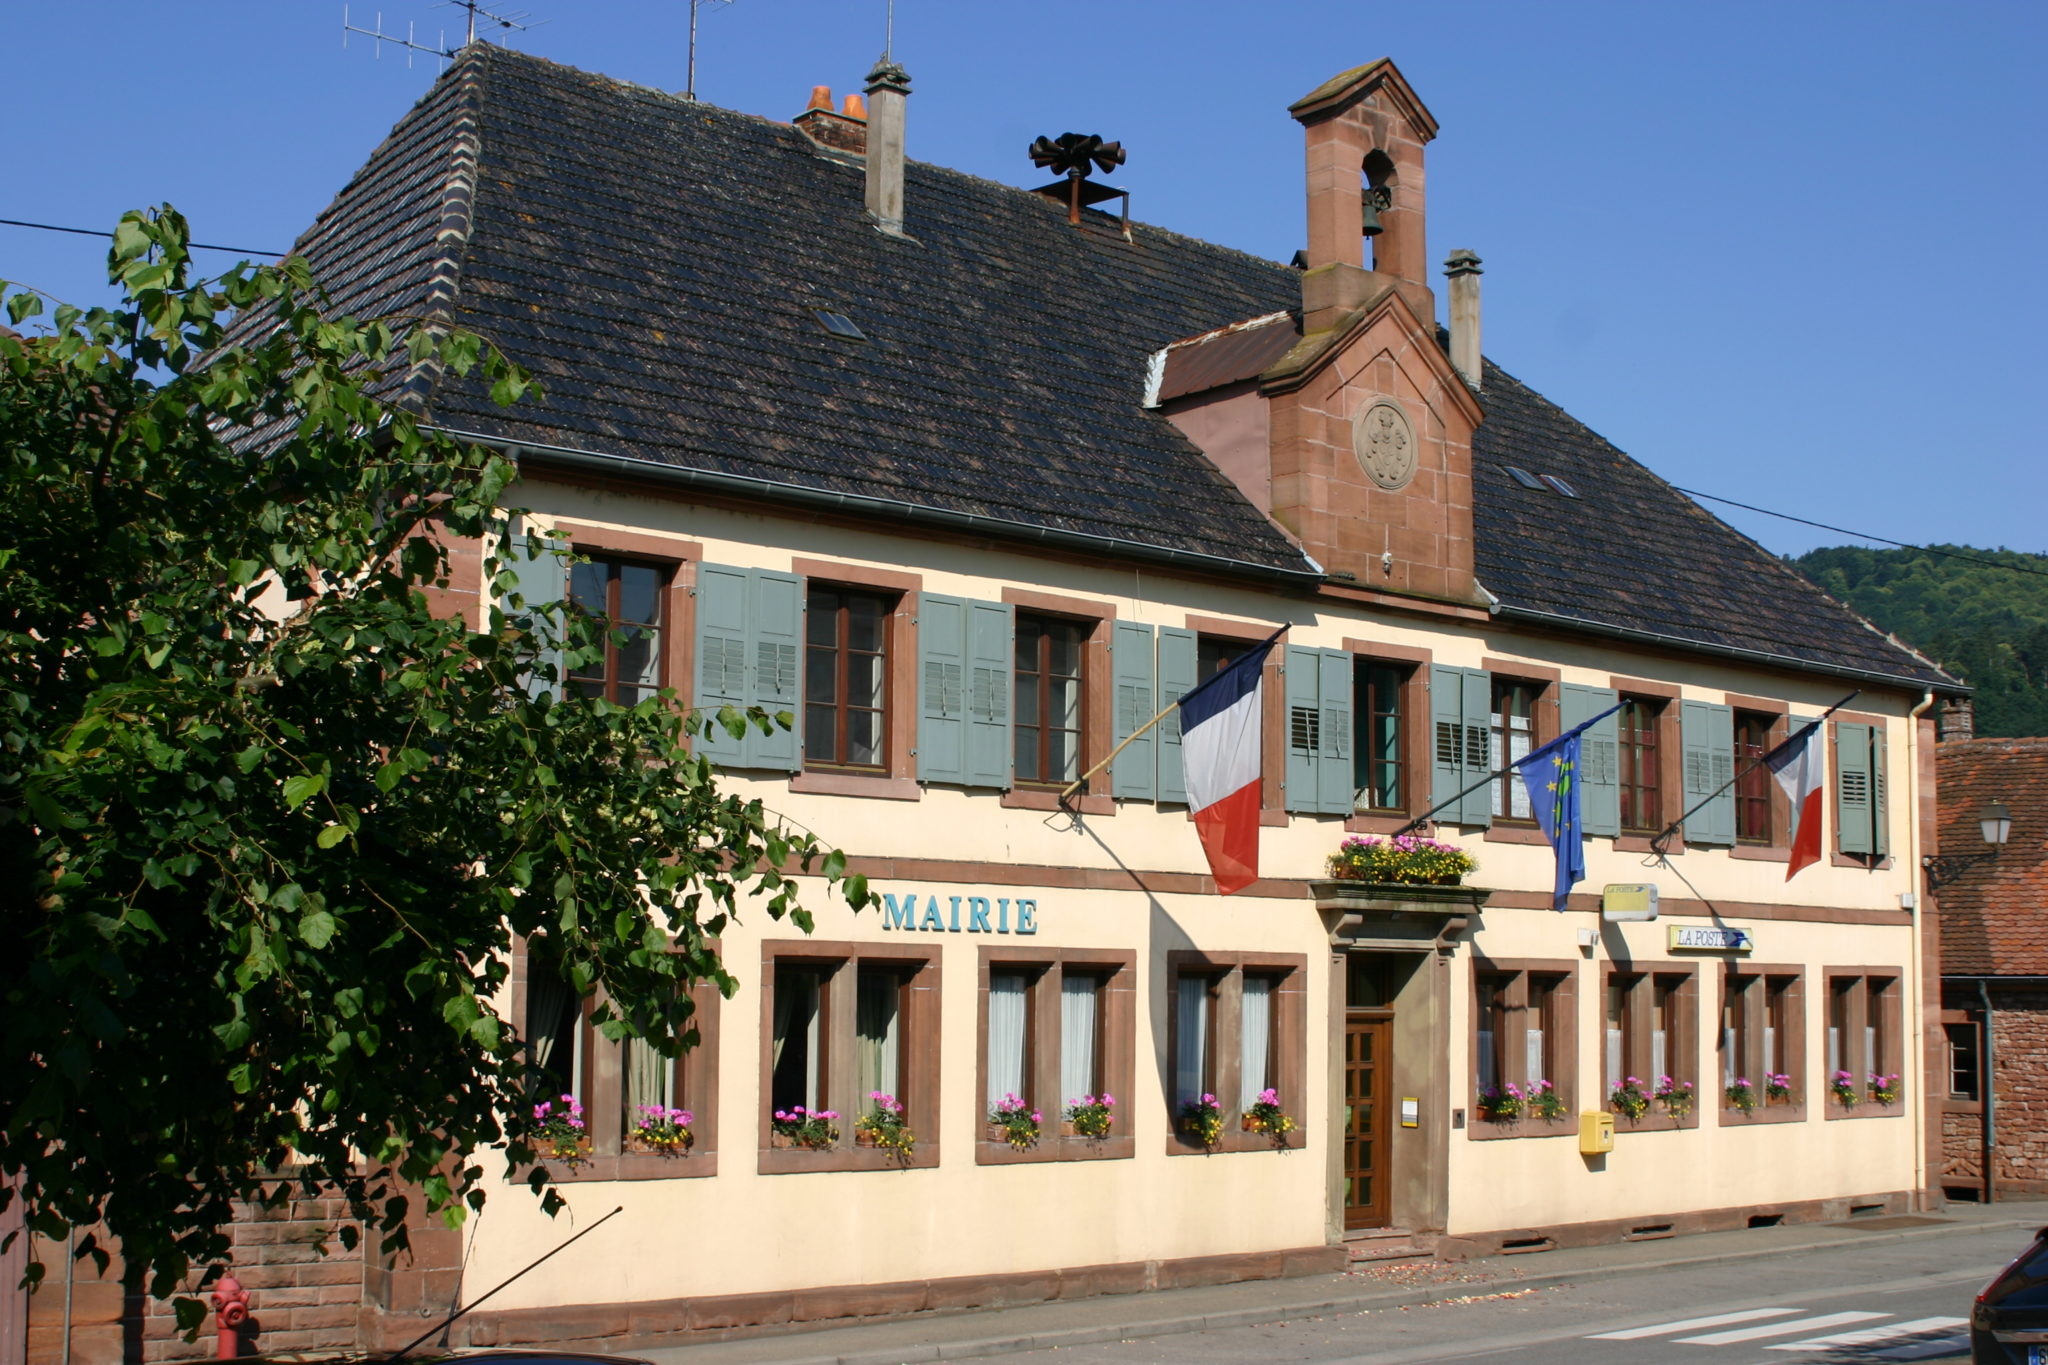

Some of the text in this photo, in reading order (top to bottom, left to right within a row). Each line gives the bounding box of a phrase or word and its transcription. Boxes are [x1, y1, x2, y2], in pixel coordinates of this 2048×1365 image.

[1607, 886, 1615, 894] LA
[882, 893, 1038, 935] MAIRIE
[1677, 930, 1728, 947] LA POSTE
